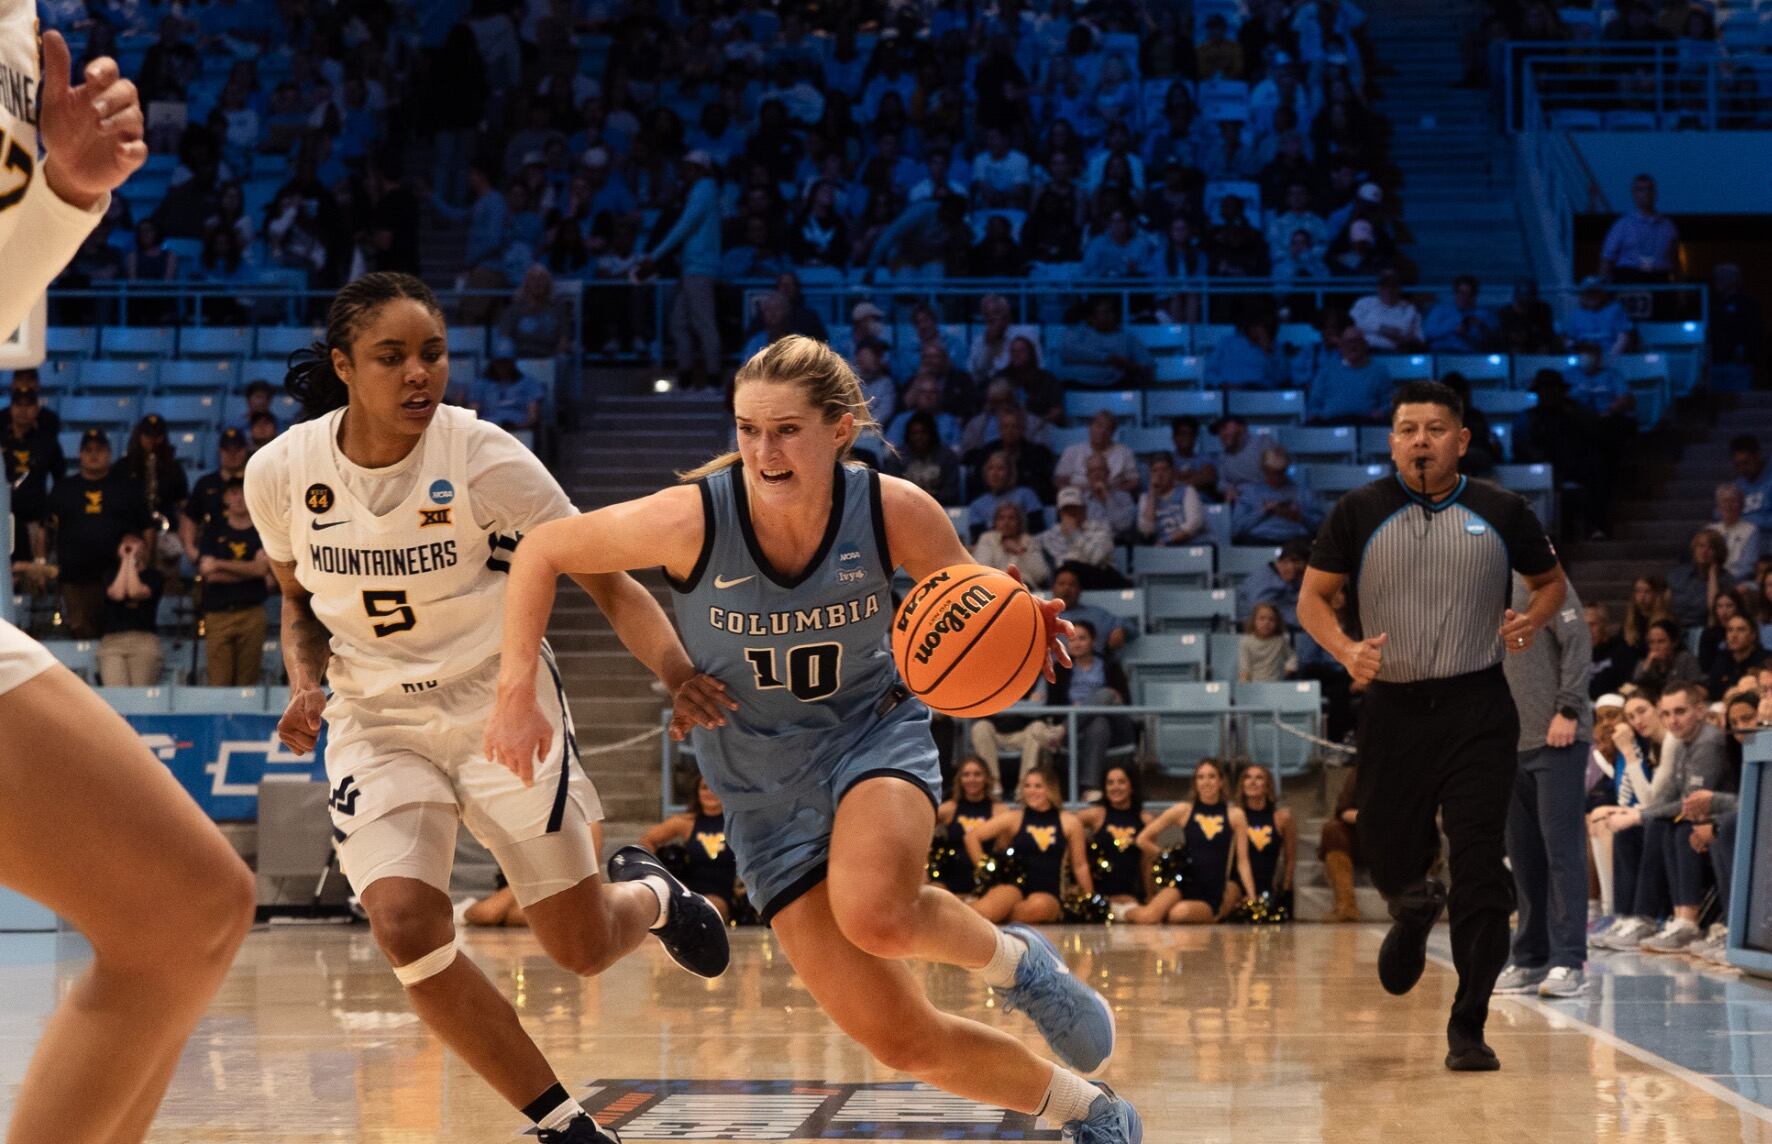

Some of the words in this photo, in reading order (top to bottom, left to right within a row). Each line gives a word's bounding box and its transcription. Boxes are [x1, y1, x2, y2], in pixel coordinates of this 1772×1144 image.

[308, 495, 329, 508] 44
[310, 539, 458, 576] MOUNTAINEERS
[839, 551, 861, 562] NCAA
[362, 590, 417, 638] 5
[709, 592, 880, 637] COLUMBIA
[896, 571, 951, 633] NCAA
[914, 584, 997, 665] Wilson
[743, 641, 843, 702] 10
